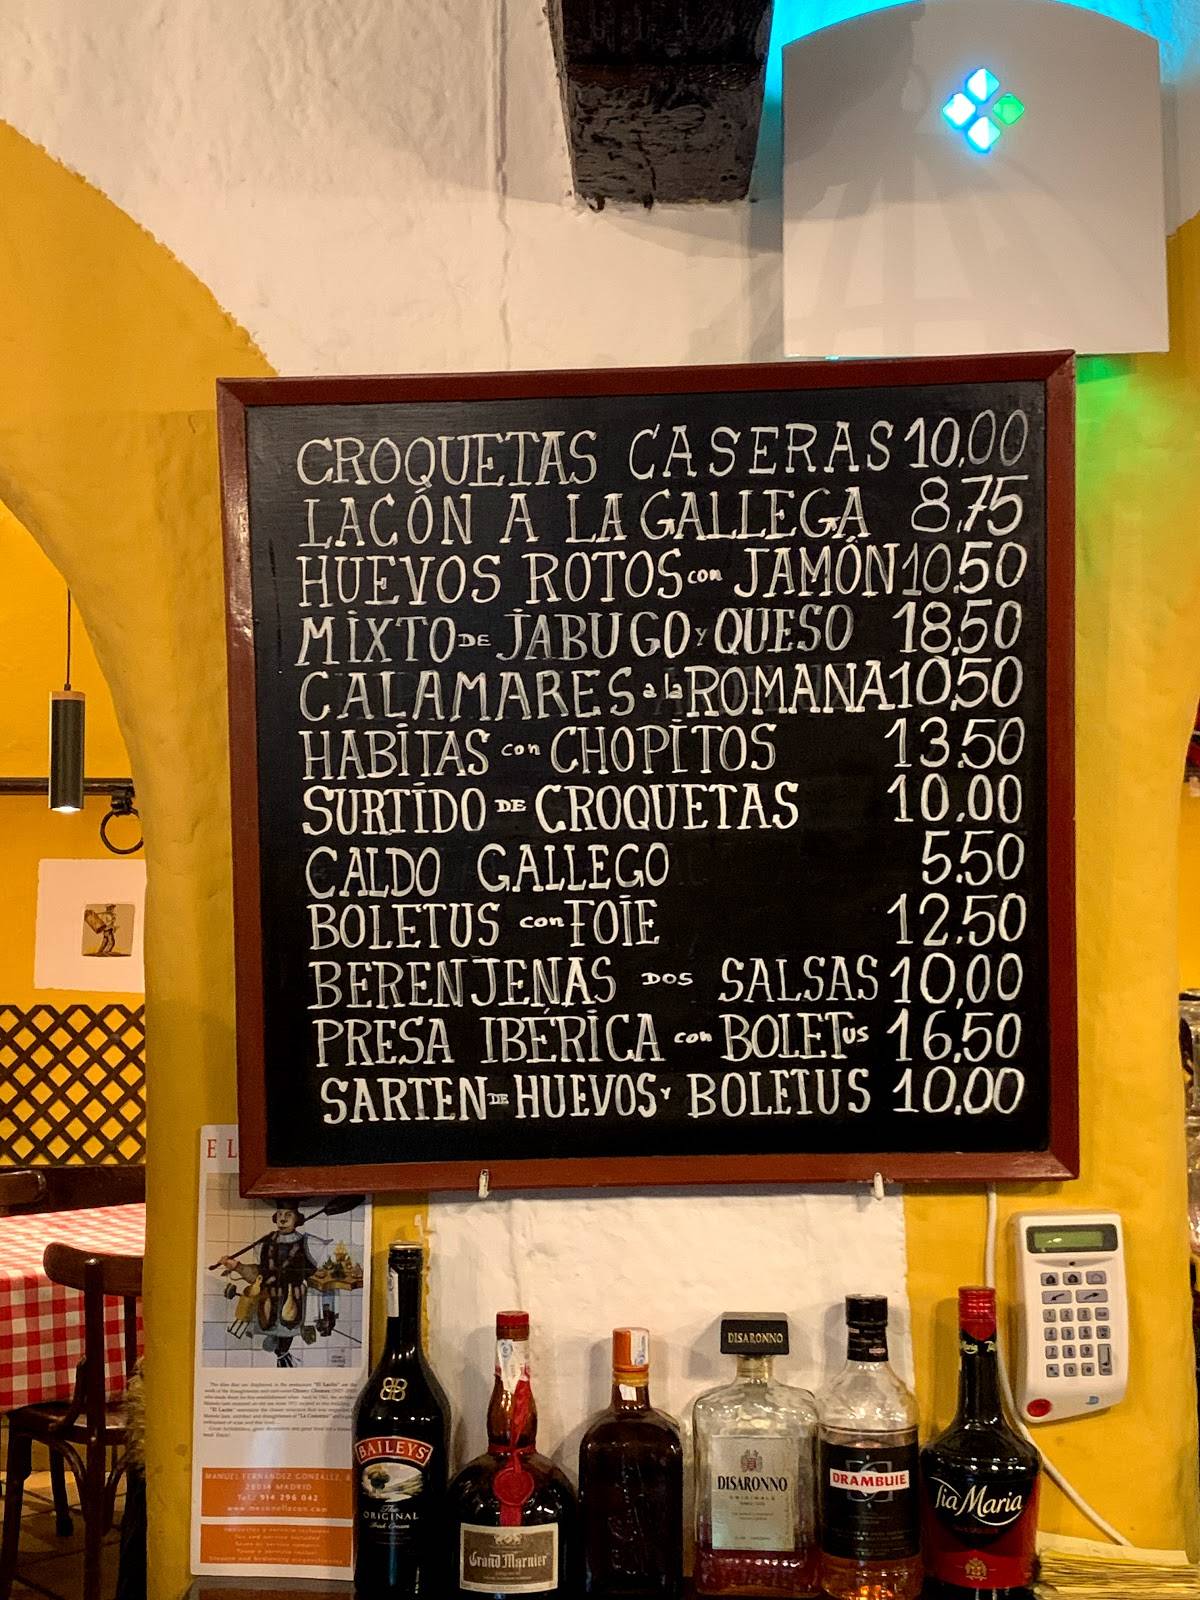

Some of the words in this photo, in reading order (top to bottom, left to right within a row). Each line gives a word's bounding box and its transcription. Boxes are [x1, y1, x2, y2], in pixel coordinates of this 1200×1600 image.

[297, 431, 597, 487] CROQUETAS
[629, 420, 894, 479] CASERAS
[299, 489, 473, 549] LACÓN
[499, 492, 539, 543] A
[565, 492, 627, 544] LA
[640, 486, 871, 540] GALLEGA
[297, 554, 501, 607] HUEVOS
[522, 549, 683, 604] ROTOS
[687, 568, 723, 584] con
[734, 536, 900, 598] JAMÓN
[295, 610, 455, 665] MIXTO
[458, 632, 491, 647] DE
[496, 608, 691, 661] JABUGO
[714, 604, 854, 655] QUESO
[300, 666, 636, 722] CALAMARES
[642, 682, 657, 699] a
[664, 672, 683, 700] la
[684, 660, 895, 717] ROMANA
[298, 723, 489, 780] HABITAS
[502, 742, 541, 756] con
[551, 719, 776, 774] CHOPITOS
[302, 783, 486, 835] SURTIDO
[495, 799, 526, 813] DE
[535, 781, 799, 833] CROQUETAS
[305, 846, 440, 898] CALDO
[477, 842, 669, 893] GALLEGO
[306, 902, 500, 950] BOLETUS
[519, 916, 564, 929] con
[306, 956, 617, 1010] BERENJENAS
[641, 971, 694, 986] DOS
[718, 954, 879, 1003] SALSAS
[312, 1017, 455, 1067] PRESA
[480, 1008, 666, 1063] IBÉRICA
[674, 1030, 713, 1044] con
[320, 1075, 488, 1125] SARTEN
[513, 1072, 657, 1120] HUEVOS
[687, 1068, 871, 1119] BOLETUS
[727, 1331, 784, 1344] DISARONNO
[358, 1440, 429, 1459] BAILEYS
[717, 1475, 788, 1492] DISARONNO
[832, 1472, 907, 1487] DRAMBUIE
[929, 1476, 962, 1510] Tia
[954, 1484, 1022, 1518] Maria
[363, 1511, 419, 1521] ORIGINAL
[468, 1551, 501, 1569] Grand
[502, 1553, 548, 1570] Marnier
